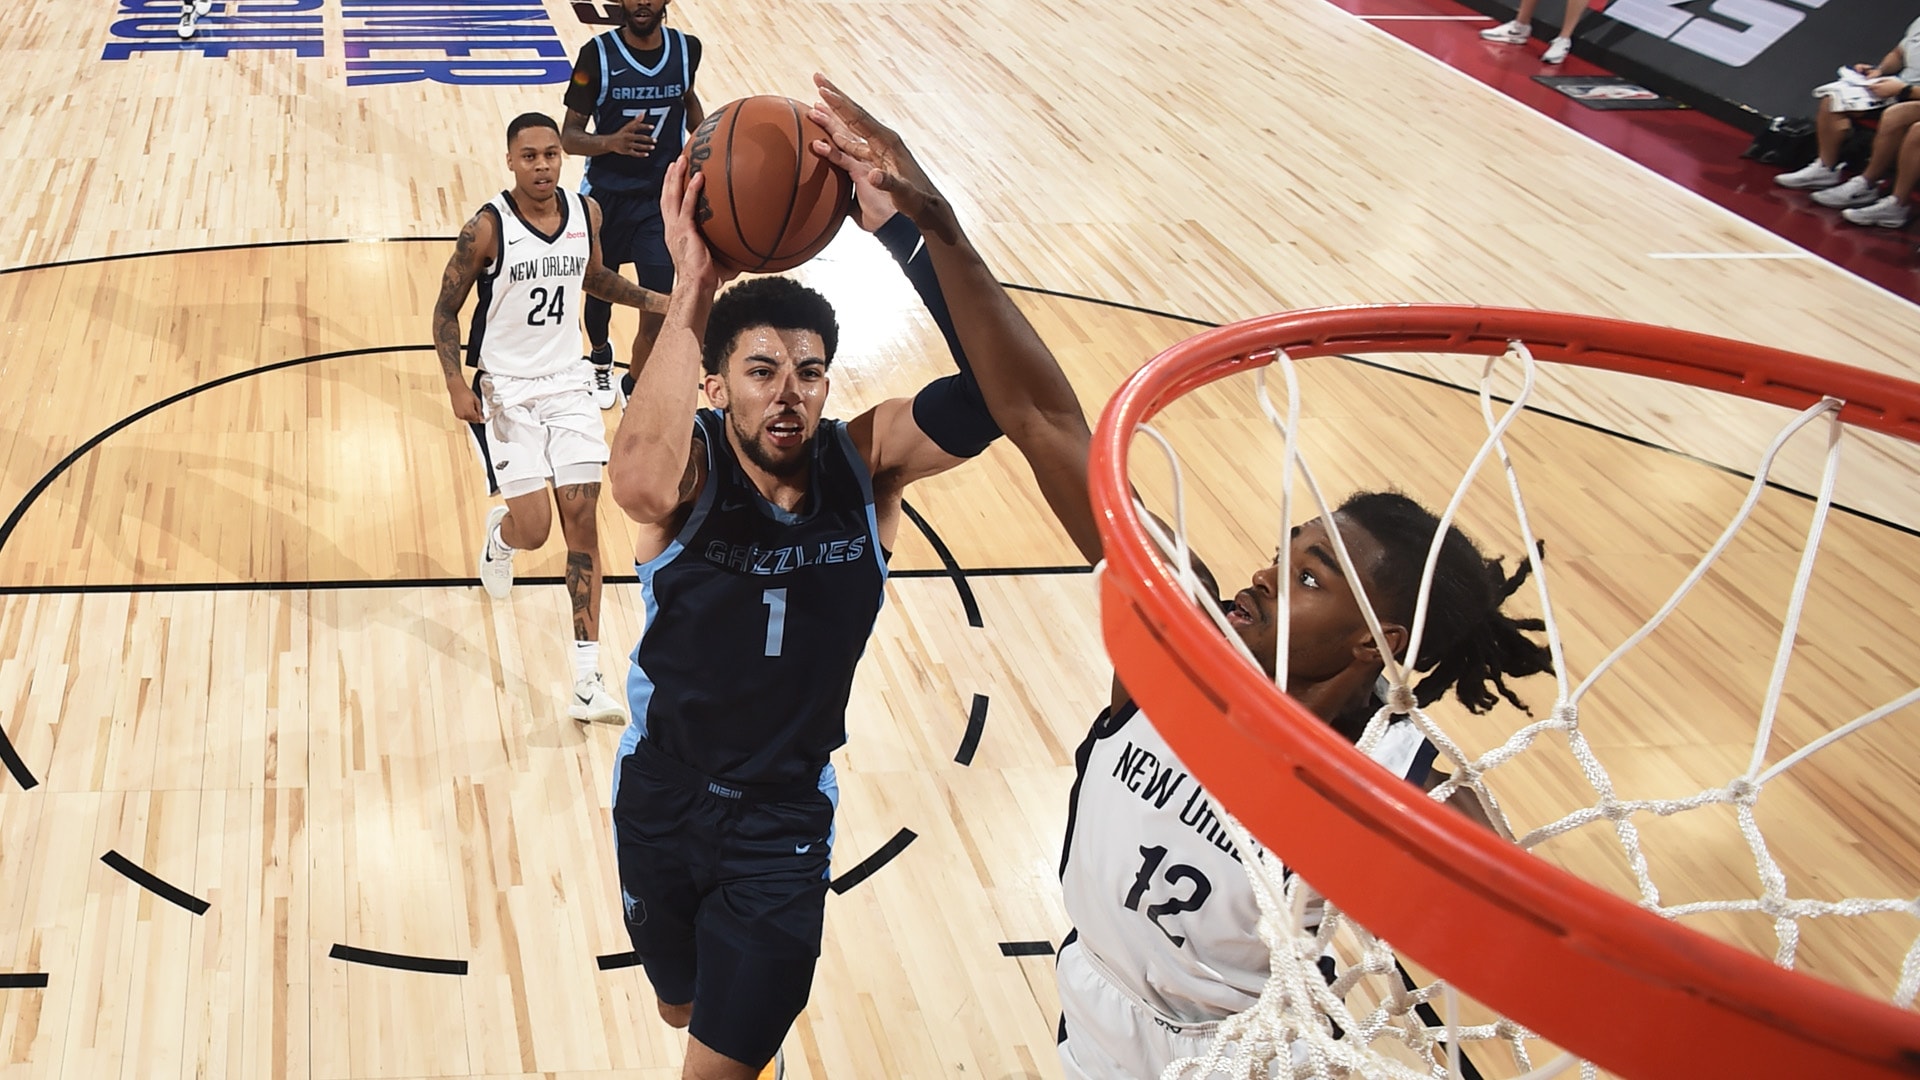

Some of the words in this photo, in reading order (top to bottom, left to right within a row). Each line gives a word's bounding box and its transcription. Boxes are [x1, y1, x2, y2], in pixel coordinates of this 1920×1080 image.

[612, 84, 682, 99] GRIZZLIES
[509, 258, 539, 284] NEW
[527, 285, 564, 326] 24
[704, 535, 867, 575] GRIZZLIES
[762, 588, 787, 656] 1
[1112, 741, 1188, 810] NEW
[1124, 845, 1212, 948] 12
